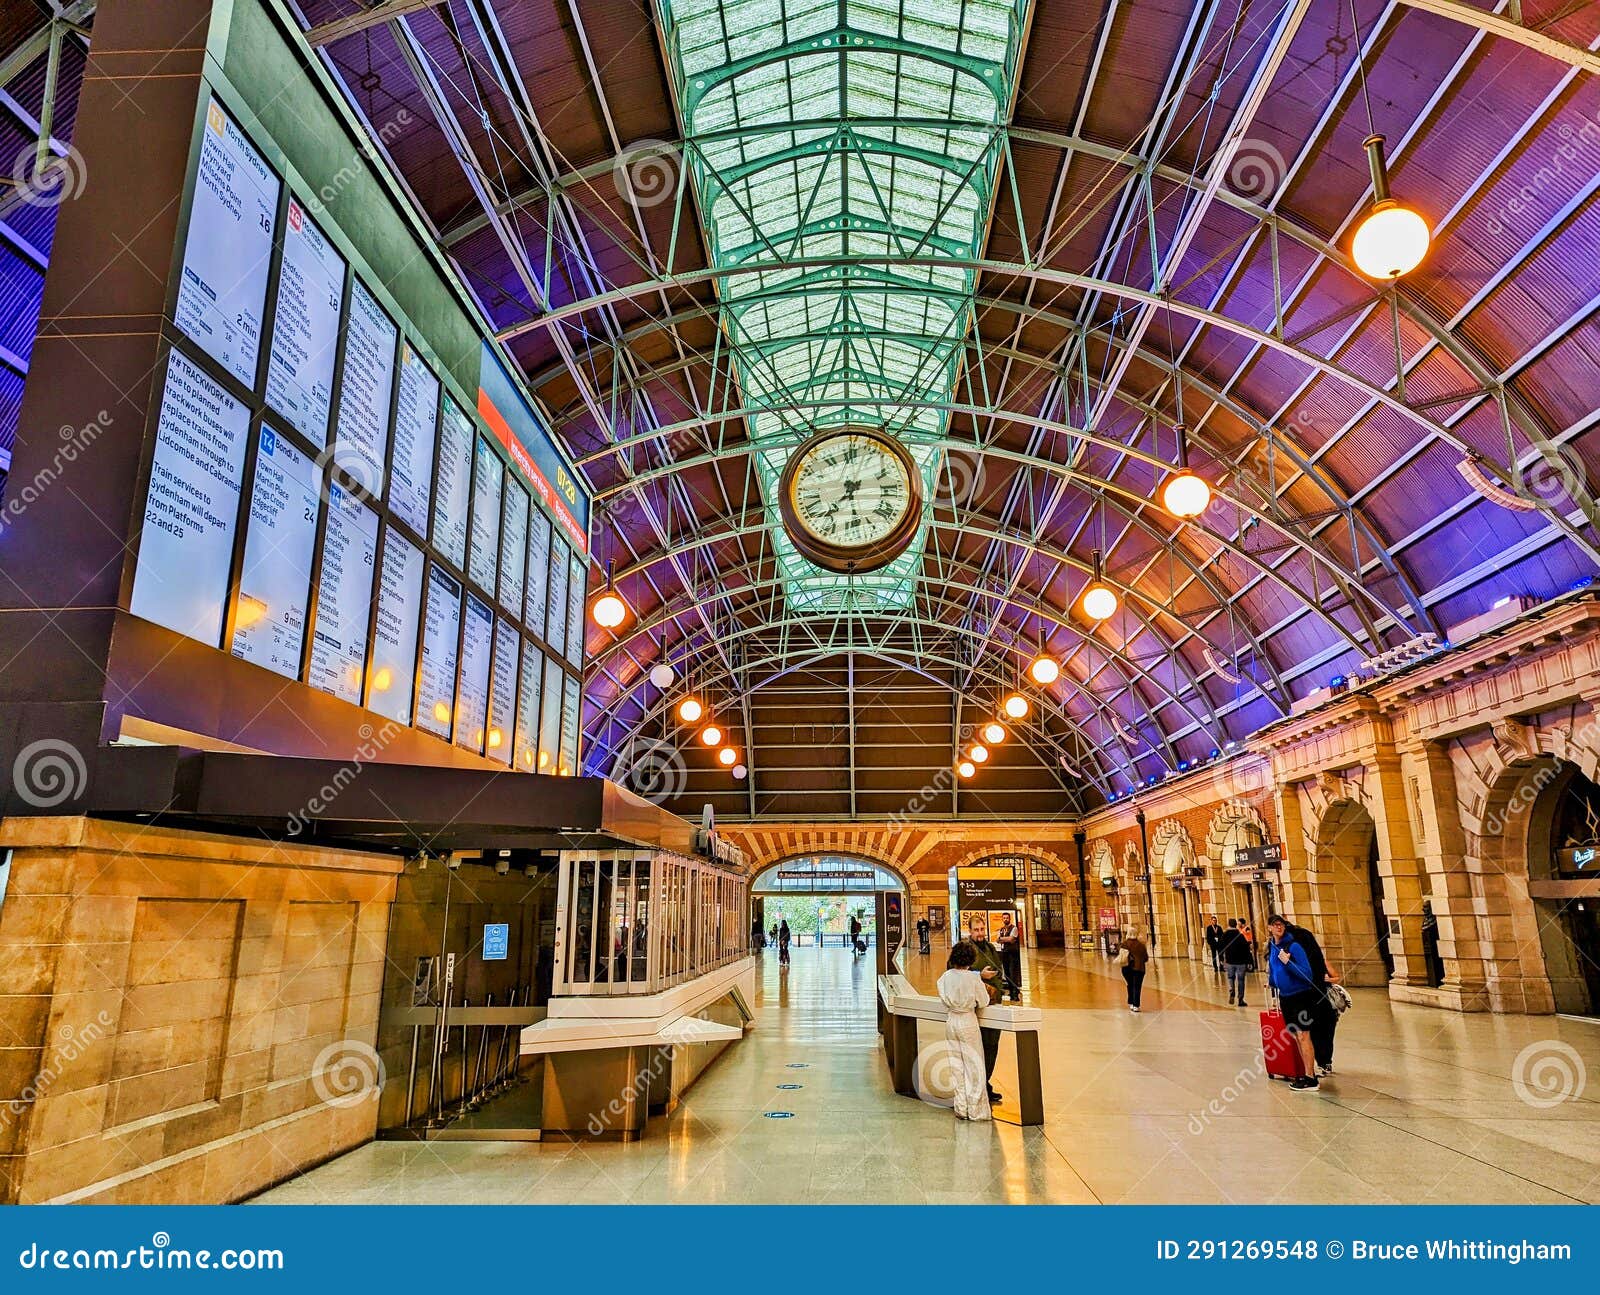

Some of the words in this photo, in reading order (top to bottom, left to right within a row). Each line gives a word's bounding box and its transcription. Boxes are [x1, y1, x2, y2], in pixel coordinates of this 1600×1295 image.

[203, 144, 230, 184] Wynyard
[205, 132, 222, 159] Town
[222, 153, 234, 174] Hall
[225, 121, 245, 153] North
[244, 145, 267, 182] Sydney
[199, 168, 218, 196] North
[218, 190, 241, 223] Sydney
[201, 156, 225, 191] Milsons
[226, 184, 241, 208] Point
[259, 211, 270, 235] 16
[302, 218, 323, 251] Hornsby
[282, 266, 304, 297] Burwood
[283, 255, 303, 284] Redfern
[179, 290, 202, 318] Hornsby
[277, 299, 299, 329] Concord
[328, 292, 337, 312] 18
[236, 312, 242, 327] 2
[242, 318, 256, 340] min
[167, 368, 182, 387] Due
[183, 380, 191, 394] to
[191, 387, 219, 419] planned
[170, 353, 181, 369] ##
[181, 362, 224, 403] TRACKWORK
[224, 396, 233, 411] ##
[311, 384, 316, 397] 5
[316, 389, 327, 407] min
[162, 399, 190, 429] replace
[191, 419, 211, 442] trains
[211, 434, 227, 453] from
[165, 383, 202, 418] trackwork
[203, 411, 222, 434] buses
[223, 427, 234, 442] will
[158, 429, 194, 462] Lidcombe
[195, 454, 208, 472] and
[160, 414, 199, 450] Sydenham
[199, 441, 226, 470] through
[226, 460, 233, 473] to
[262, 432, 273, 451] T4
[275, 438, 292, 459] Bondi
[153, 461, 172, 482] Train
[173, 474, 202, 501] services
[203, 492, 210, 506] to
[256, 470, 274, 490] Martin
[274, 483, 289, 501] Place
[257, 458, 272, 476] Town
[272, 469, 283, 484] Hall
[150, 477, 190, 511] Sydenham
[191, 501, 203, 517] will
[203, 509, 226, 533] depart
[252, 494, 277, 519] Edgecliff
[254, 482, 269, 501] Kings
[270, 493, 284, 511] Cross
[145, 509, 158, 525] 22
[157, 516, 172, 533] and
[173, 525, 183, 539] 25
[148, 493, 168, 513] from
[168, 504, 203, 534] Platforms
[251, 506, 268, 524] Bondi
[304, 507, 314, 525] 24
[363, 550, 372, 566] 25
[283, 612, 289, 623] 9
[289, 615, 301, 629] min
[887, 924, 900, 934] Entry
